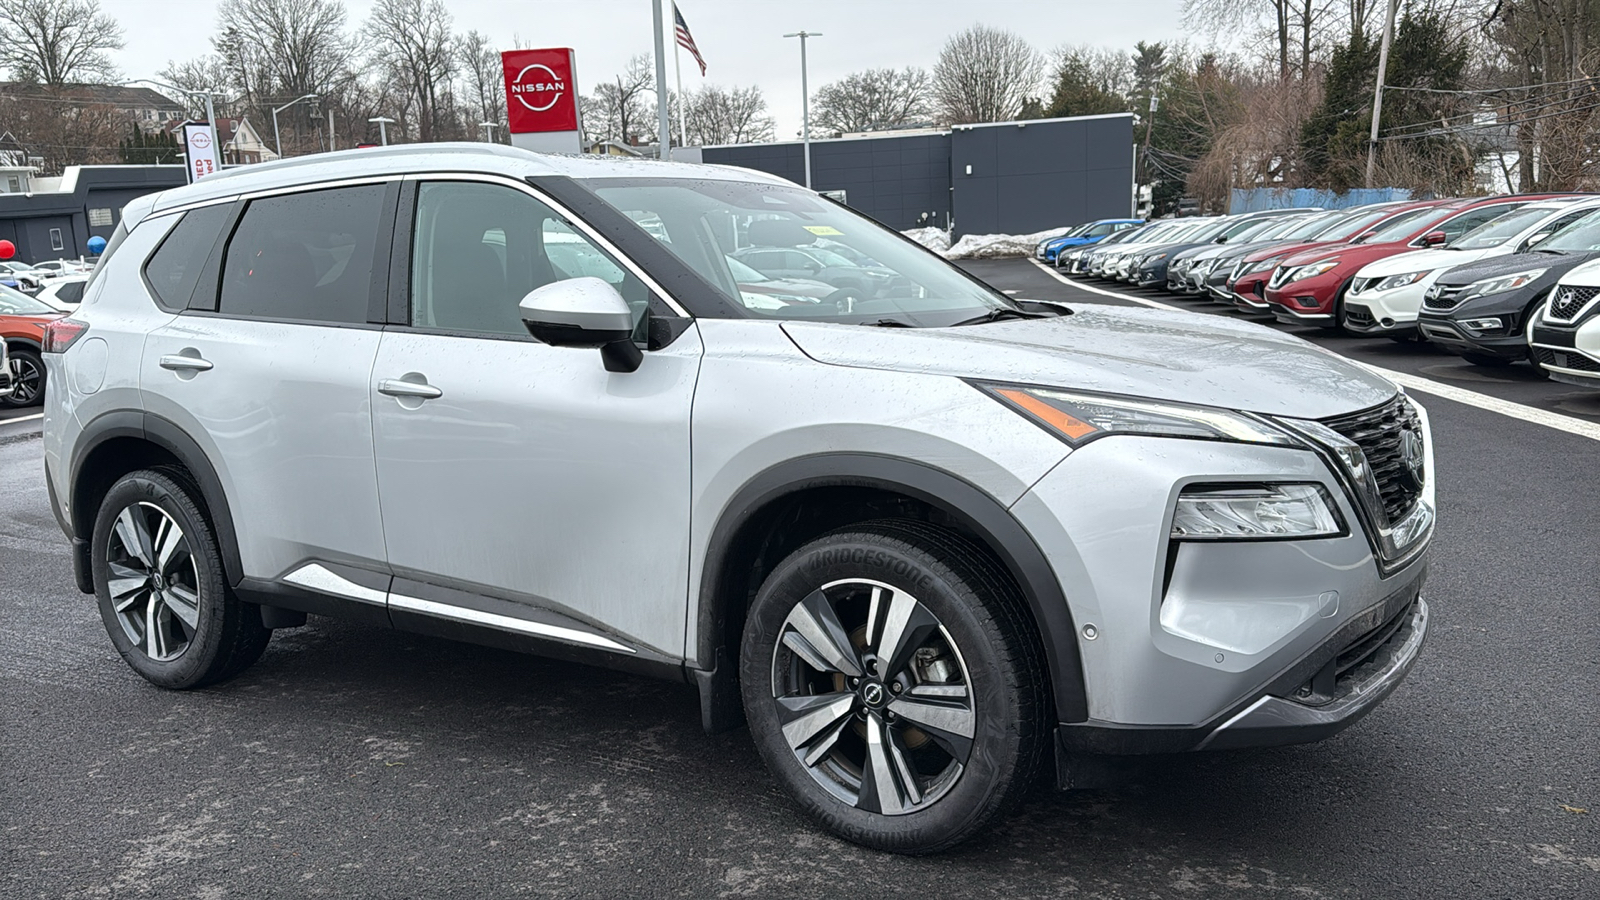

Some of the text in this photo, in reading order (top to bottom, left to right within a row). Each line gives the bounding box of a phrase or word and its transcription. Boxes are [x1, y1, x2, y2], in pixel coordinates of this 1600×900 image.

[511, 82, 565, 93] NISSAN
[195, 159, 204, 179] IED
[808, 547, 933, 590] BRIDGESTONE
